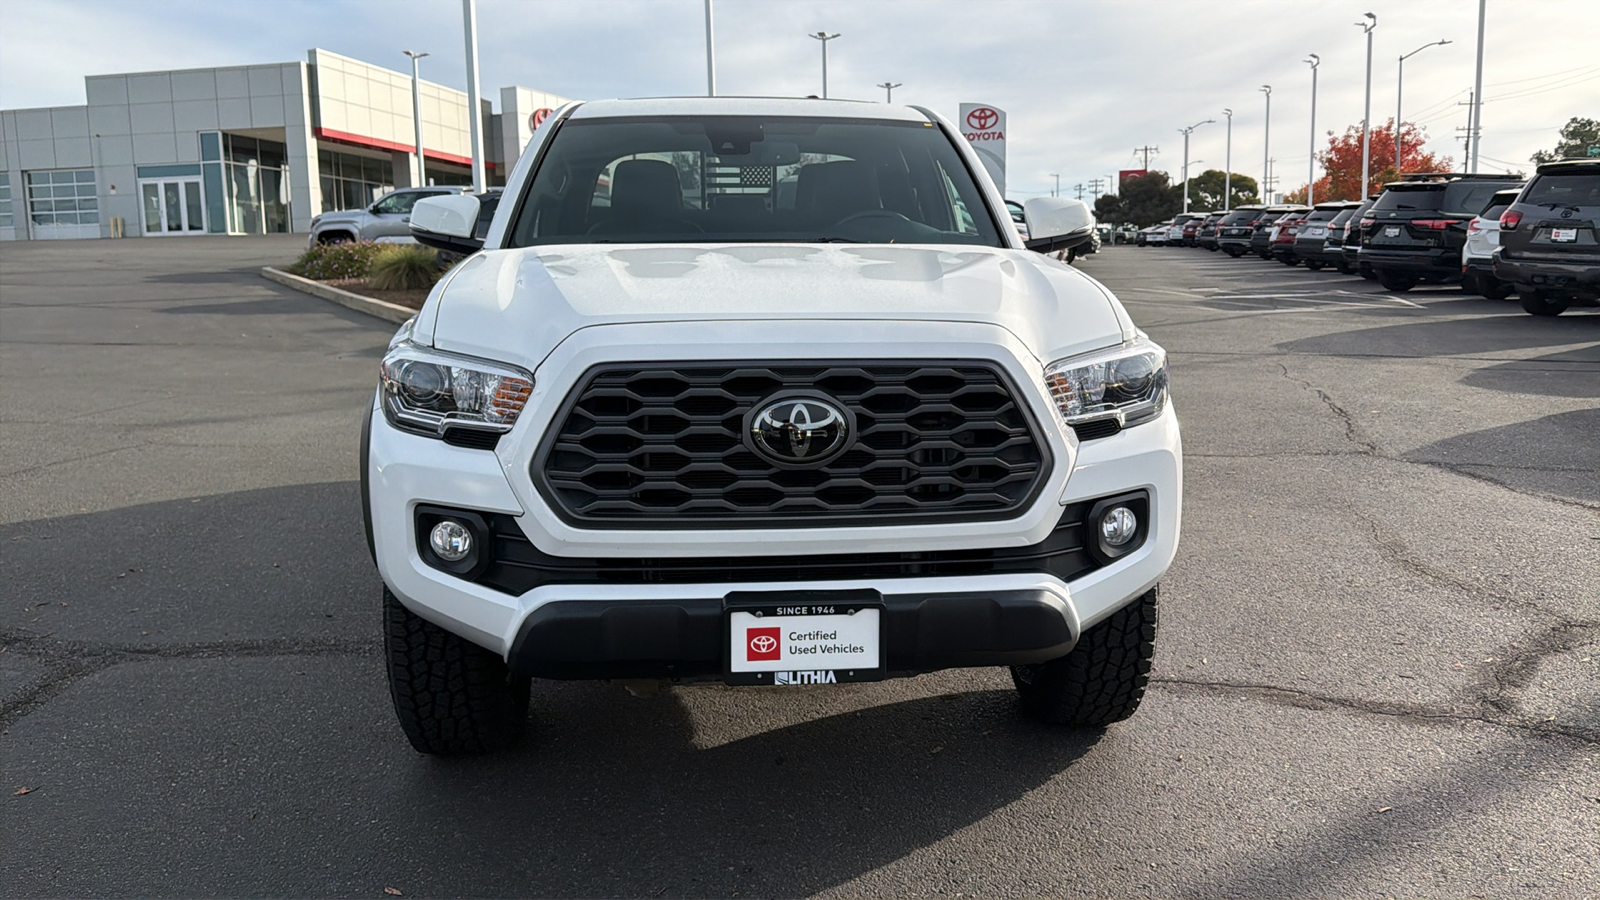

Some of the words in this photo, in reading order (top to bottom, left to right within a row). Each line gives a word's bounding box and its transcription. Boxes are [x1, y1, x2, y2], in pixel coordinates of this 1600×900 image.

[776, 606, 808, 615] SINCE
[811, 605, 835, 614] 1946
[789, 630, 837, 641] Certified
[789, 644, 817, 655] Used
[819, 643, 865, 654] Vehicles
[788, 670, 837, 685] LITHIA
